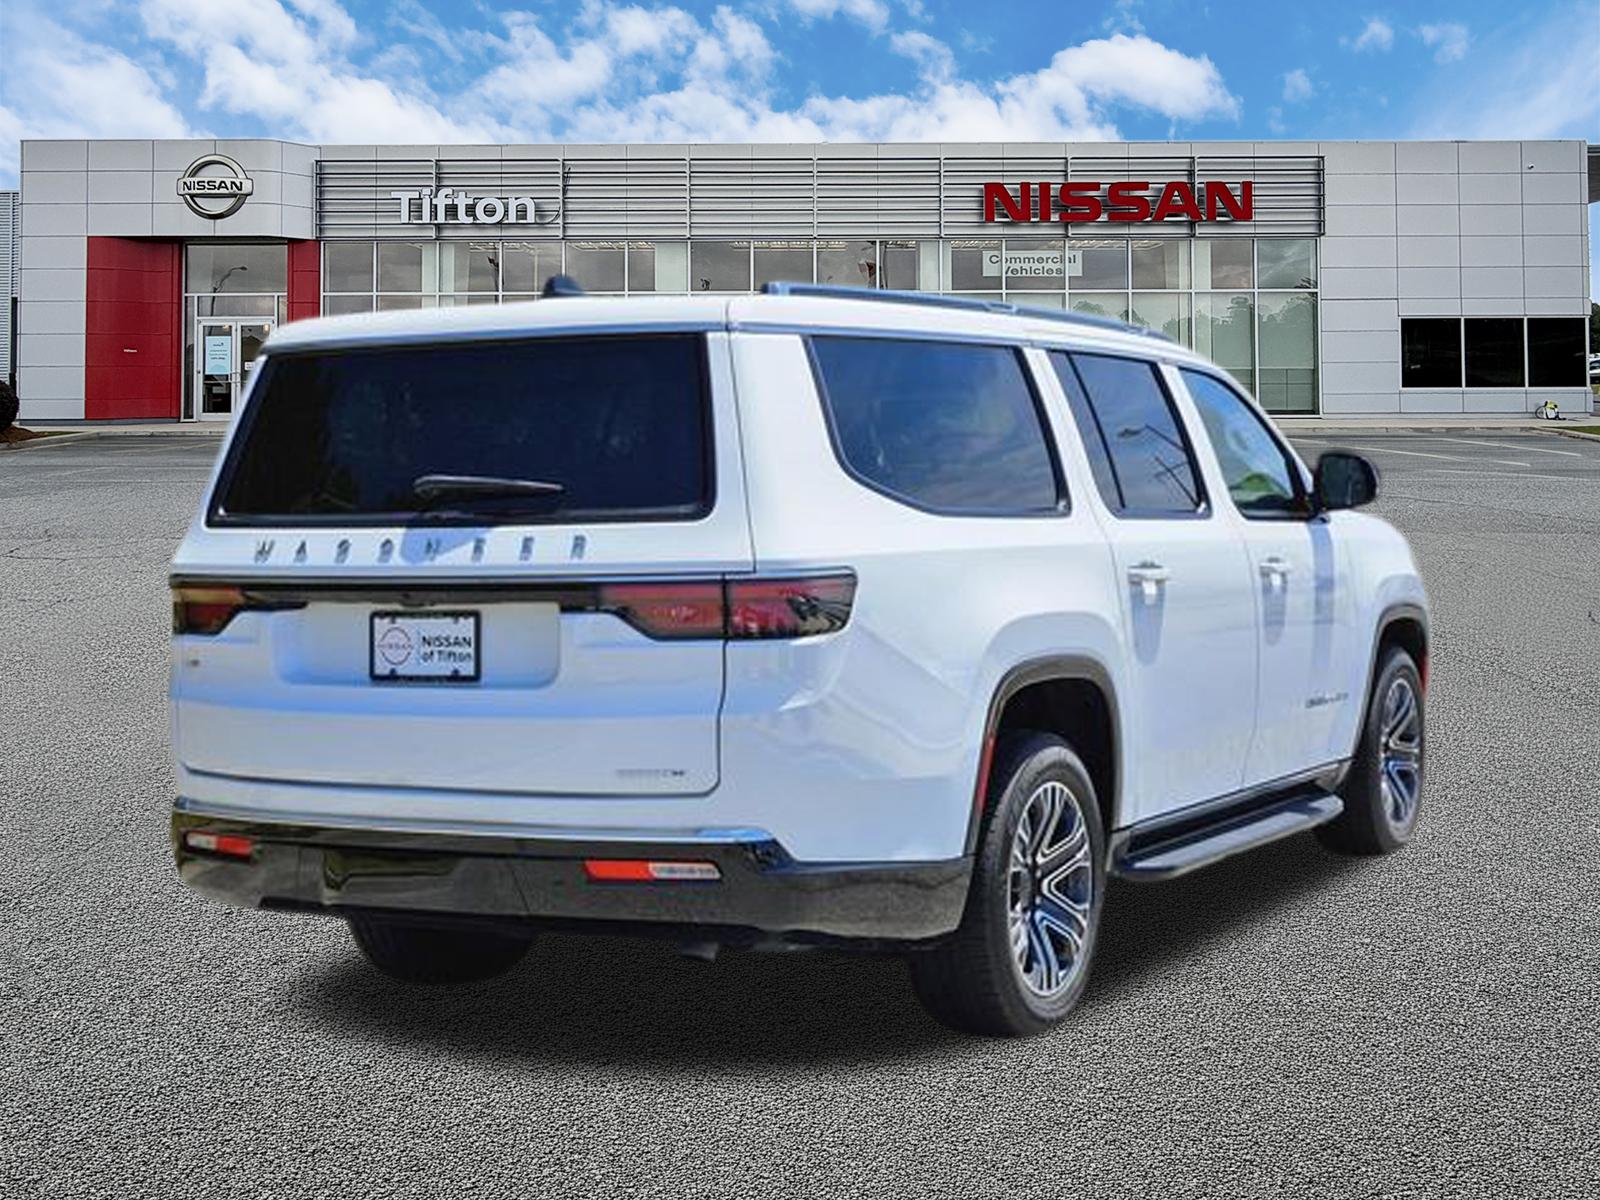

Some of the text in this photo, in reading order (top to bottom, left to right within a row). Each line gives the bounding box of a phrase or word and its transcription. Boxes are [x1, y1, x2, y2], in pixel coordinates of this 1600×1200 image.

[182, 180, 243, 192] NISSAN
[390, 188, 536, 224] Tifton
[983, 180, 1254, 222] NISSAN
[422, 635, 472, 648] NISSAN
[421, 650, 472, 663] of Tifton
